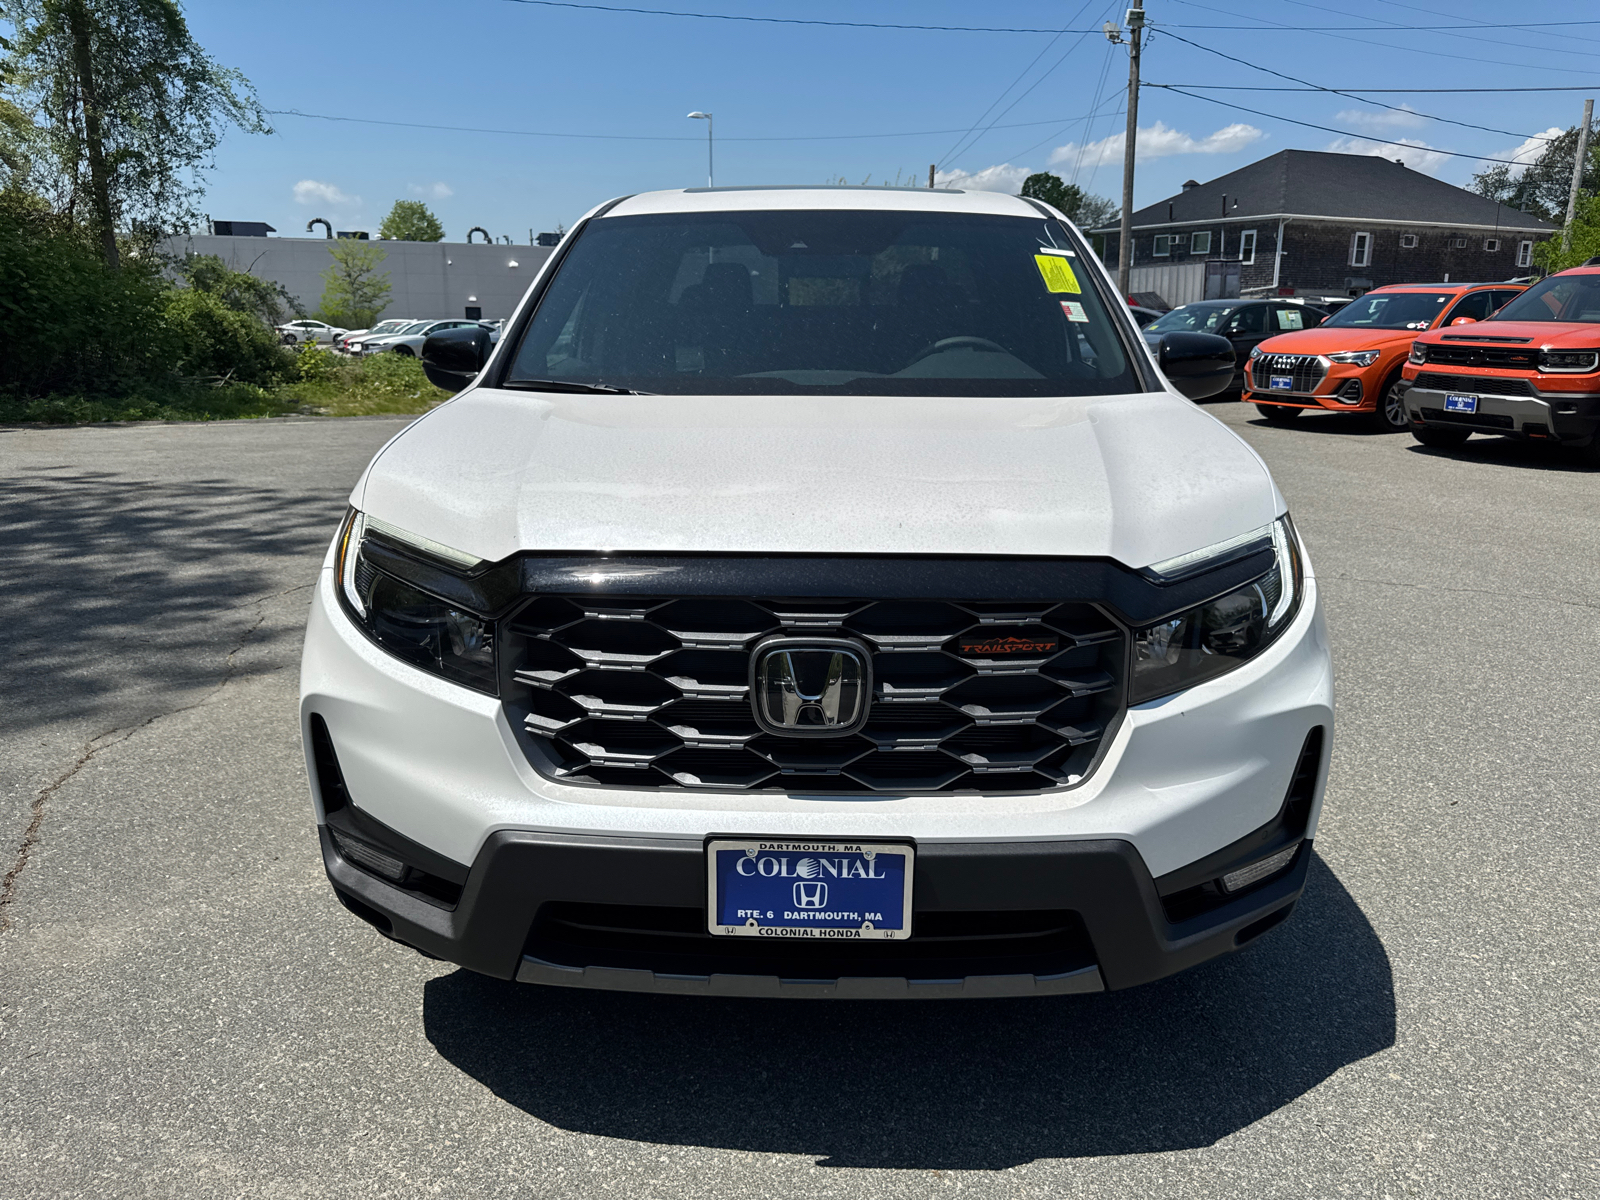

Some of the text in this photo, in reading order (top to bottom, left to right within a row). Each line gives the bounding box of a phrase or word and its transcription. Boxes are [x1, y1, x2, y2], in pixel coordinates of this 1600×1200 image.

[961, 642, 1056, 653] TRAILSPORT
[736, 856, 886, 879] COLONIAL
[737, 909, 883, 922] RTE. 6 DARTMOUTH, MA
[758, 927, 861, 938] COLONIAL HONDA
